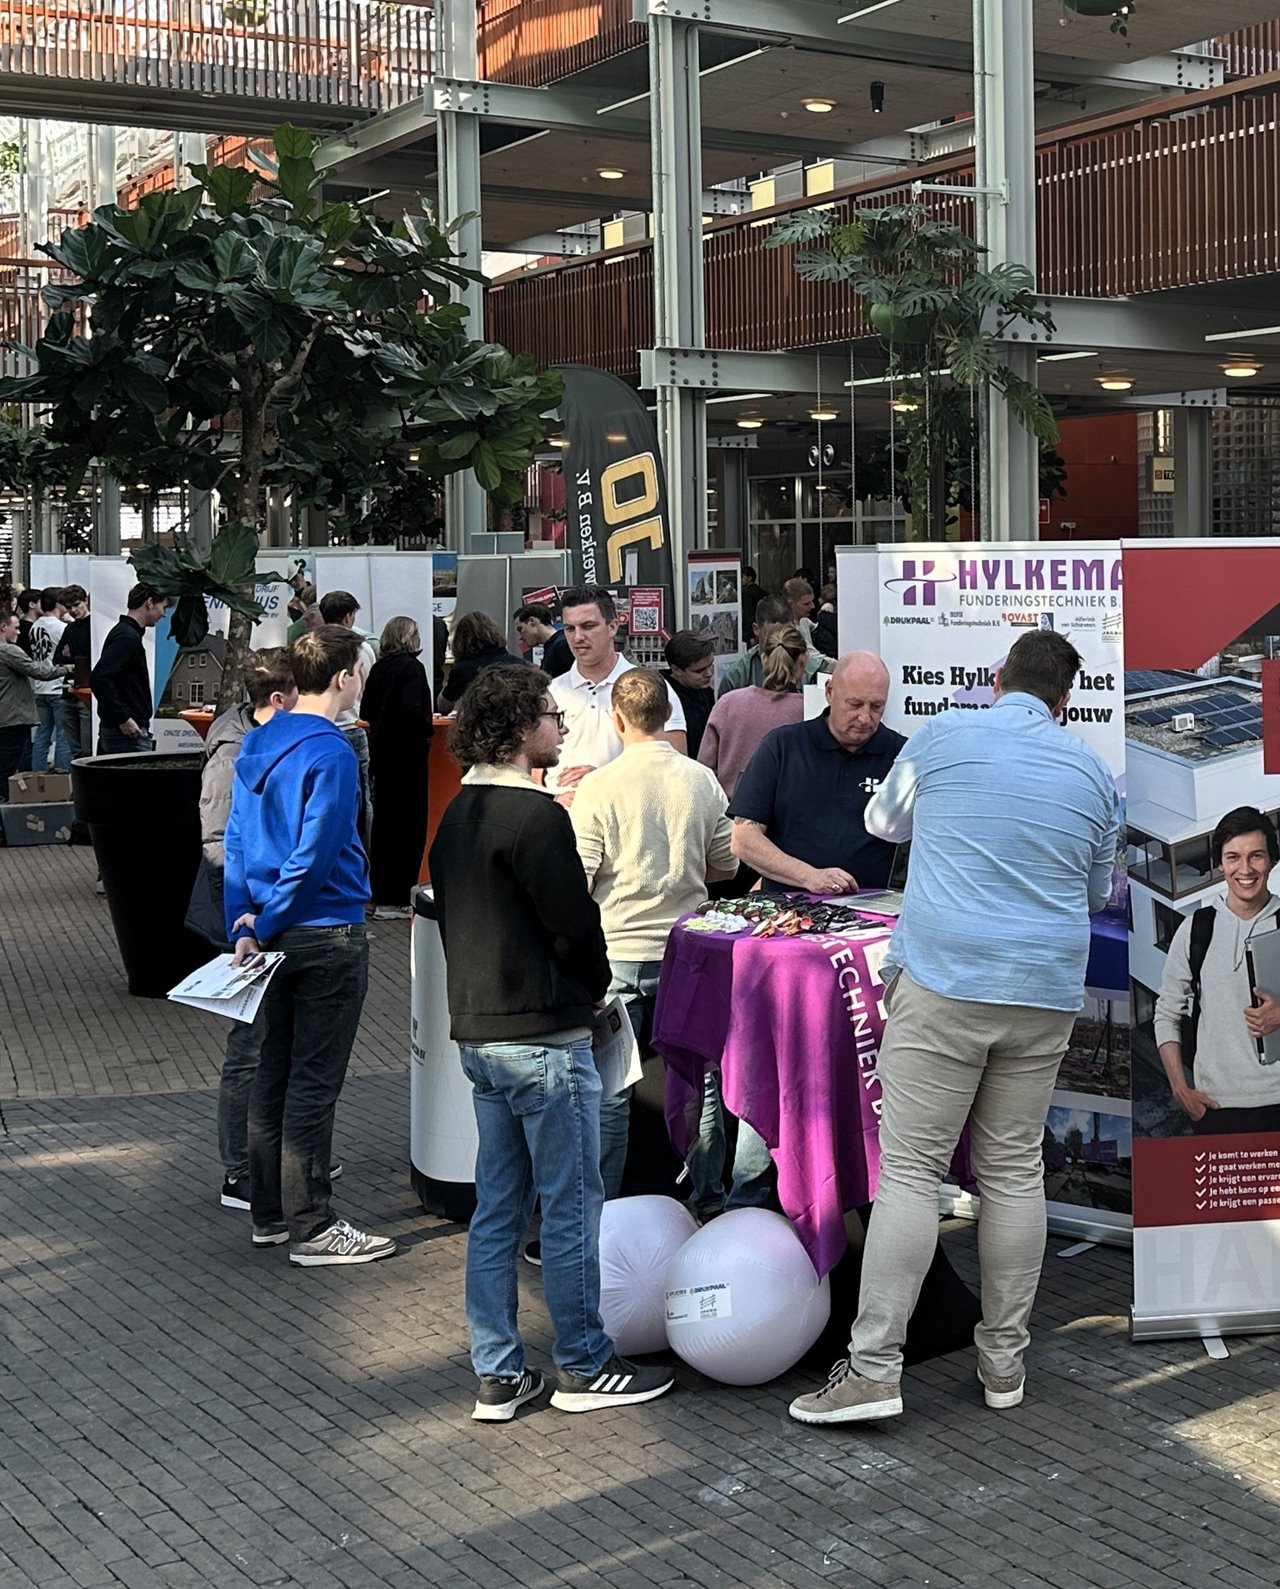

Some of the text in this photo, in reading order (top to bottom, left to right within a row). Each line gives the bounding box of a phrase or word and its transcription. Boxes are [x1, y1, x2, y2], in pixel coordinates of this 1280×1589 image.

[960, 595, 1106, 607] FUNDERINGSTECHNIEK
[890, 617, 931, 625] DRUKPAAL
[902, 666, 1115, 691] Kies Hylk het
[1060, 706, 1113, 726] jouw
[1218, 1151, 1239, 1159] komt
[1250, 1148, 1278, 1158] werken
[1219, 1164, 1237, 1173] gaat
[1238, 1161, 1266, 1170] werken
[1219, 1174, 1240, 1185] krijgt
[1219, 1186, 1237, 1195] hebt
[1239, 1186, 1257, 1194] kans
[1259, 1186, 1268, 1195] op
[1219, 1198, 1241, 1209] krijgt
